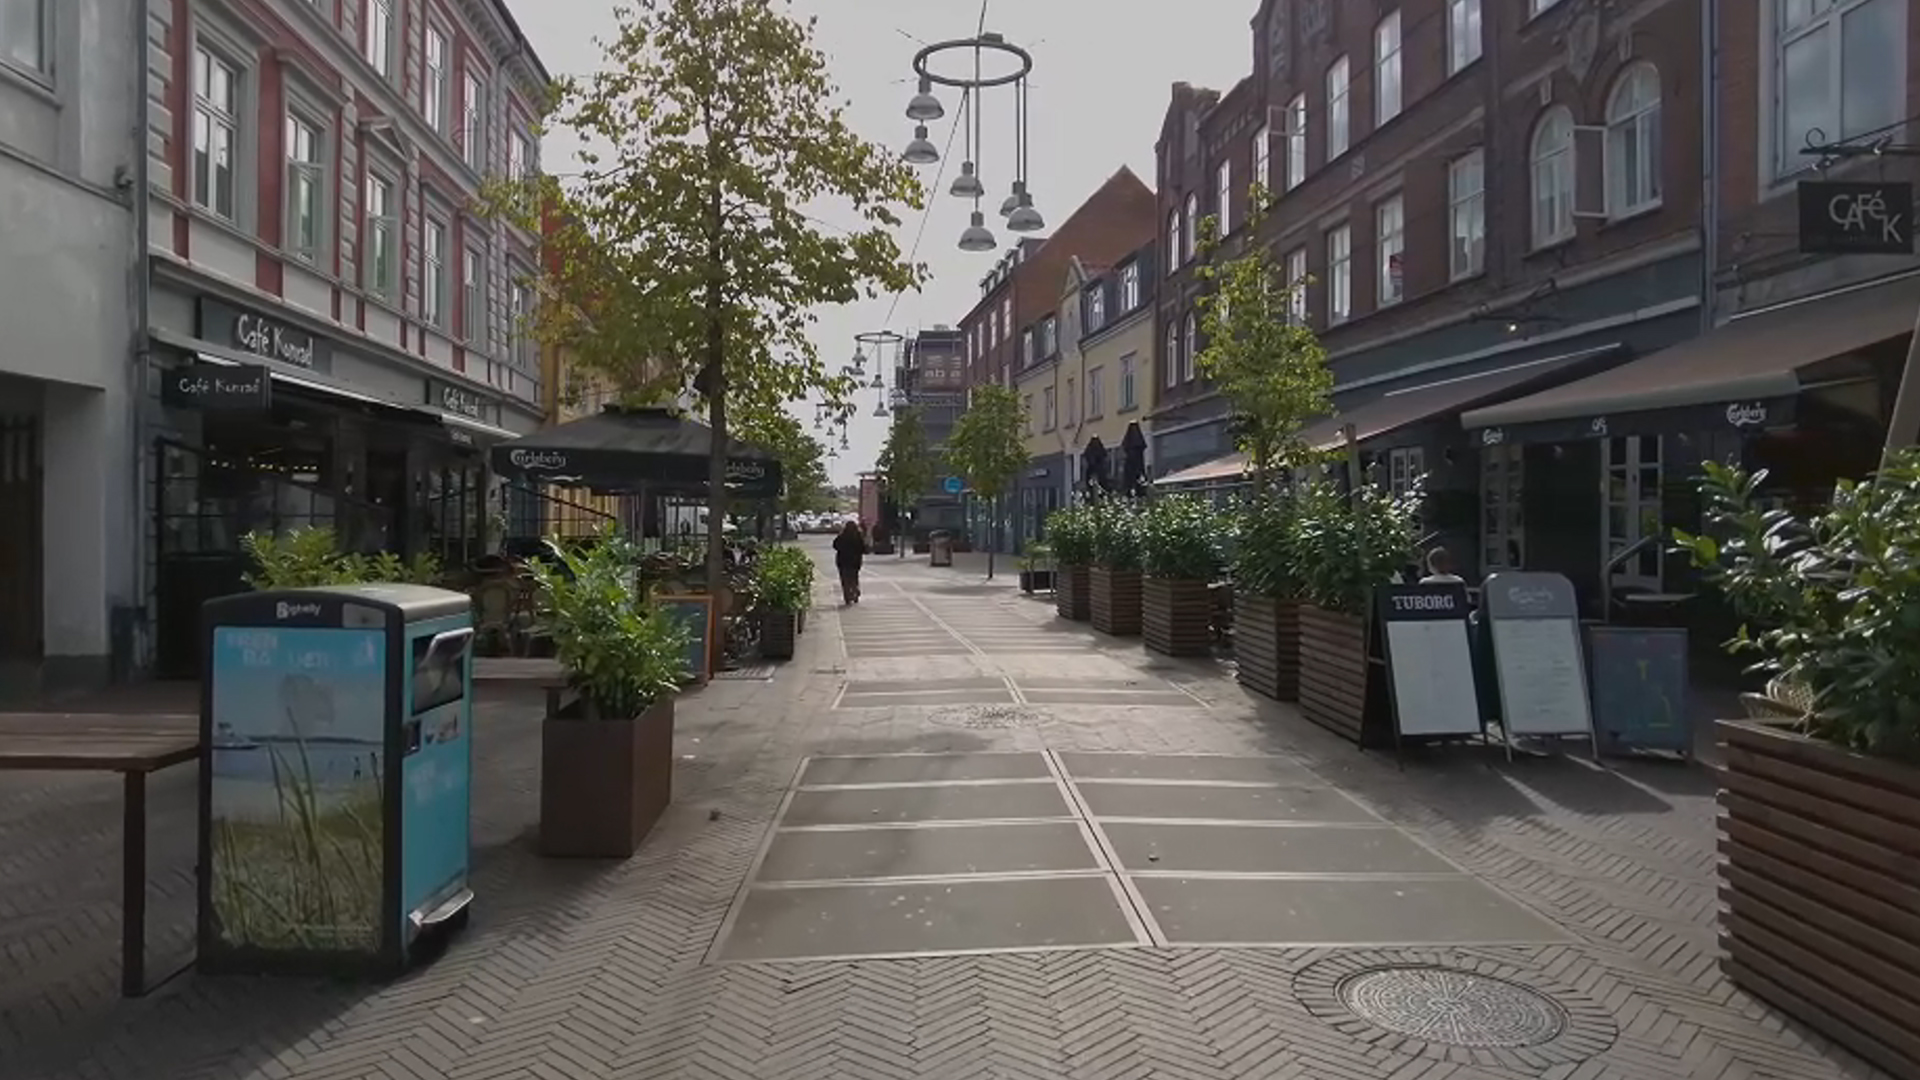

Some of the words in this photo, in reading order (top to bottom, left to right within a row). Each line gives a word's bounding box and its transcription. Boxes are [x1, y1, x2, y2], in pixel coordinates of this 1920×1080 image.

[1882, 213, 1903, 243] K
[238, 313, 269, 354] Café
[273, 326, 313, 367] Konrad
[178, 377, 209, 397] Café
[215, 378, 260, 393] Konrad
[1726, 402, 1767, 427] Carlsberg
[510, 449, 566, 469] Carlsberg
[1391, 594, 1454, 610] TUBORG
